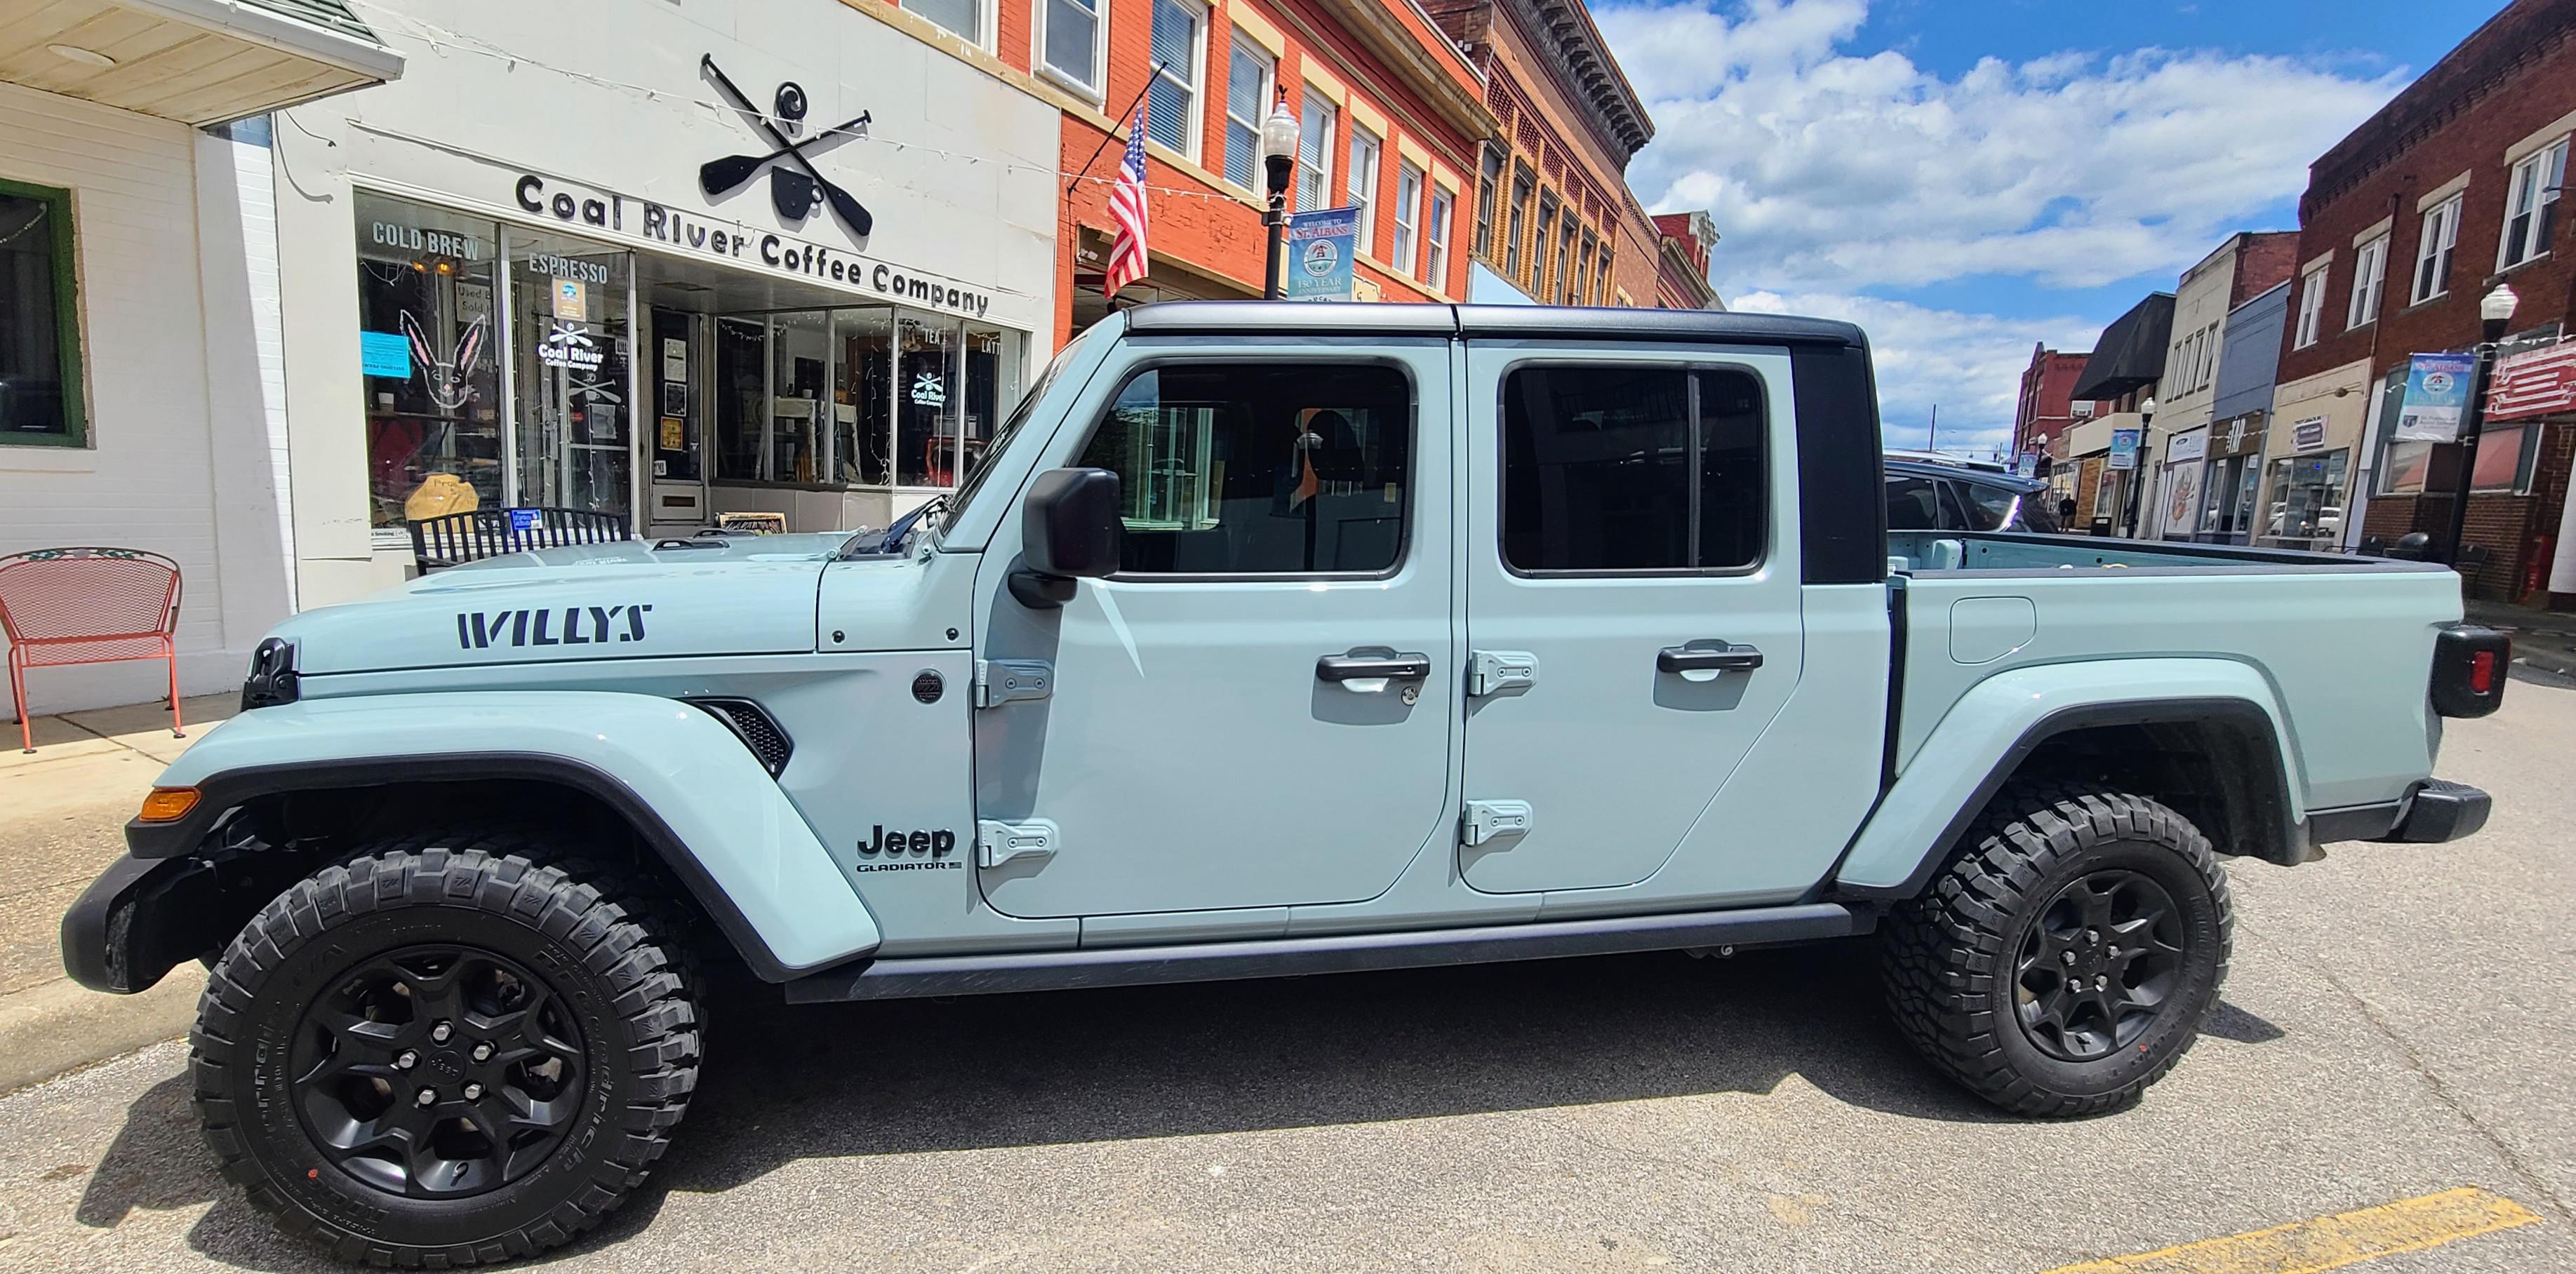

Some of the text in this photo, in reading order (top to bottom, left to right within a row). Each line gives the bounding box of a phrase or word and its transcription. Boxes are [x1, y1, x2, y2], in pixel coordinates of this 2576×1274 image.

[1313, 226, 1348, 238] ALBANS
[373, 221, 479, 261] COLD BREW
[516, 175, 989, 317] Coal River Coffee Company
[529, 253, 608, 285] ESPRESSO
[1313, 277, 1342, 288] YEAR
[462, 301, 483, 313] Sold
[924, 329, 940, 345] TEA
[538, 344, 568, 360] Coal
[570, 347, 604, 364] River
[545, 358, 599, 372] Coffee Company
[912, 389, 947, 402] Coal River
[457, 604, 653, 650] WILLYS
[857, 824, 956, 859] Jeep
[856, 862, 947, 873] GLADIATOR
